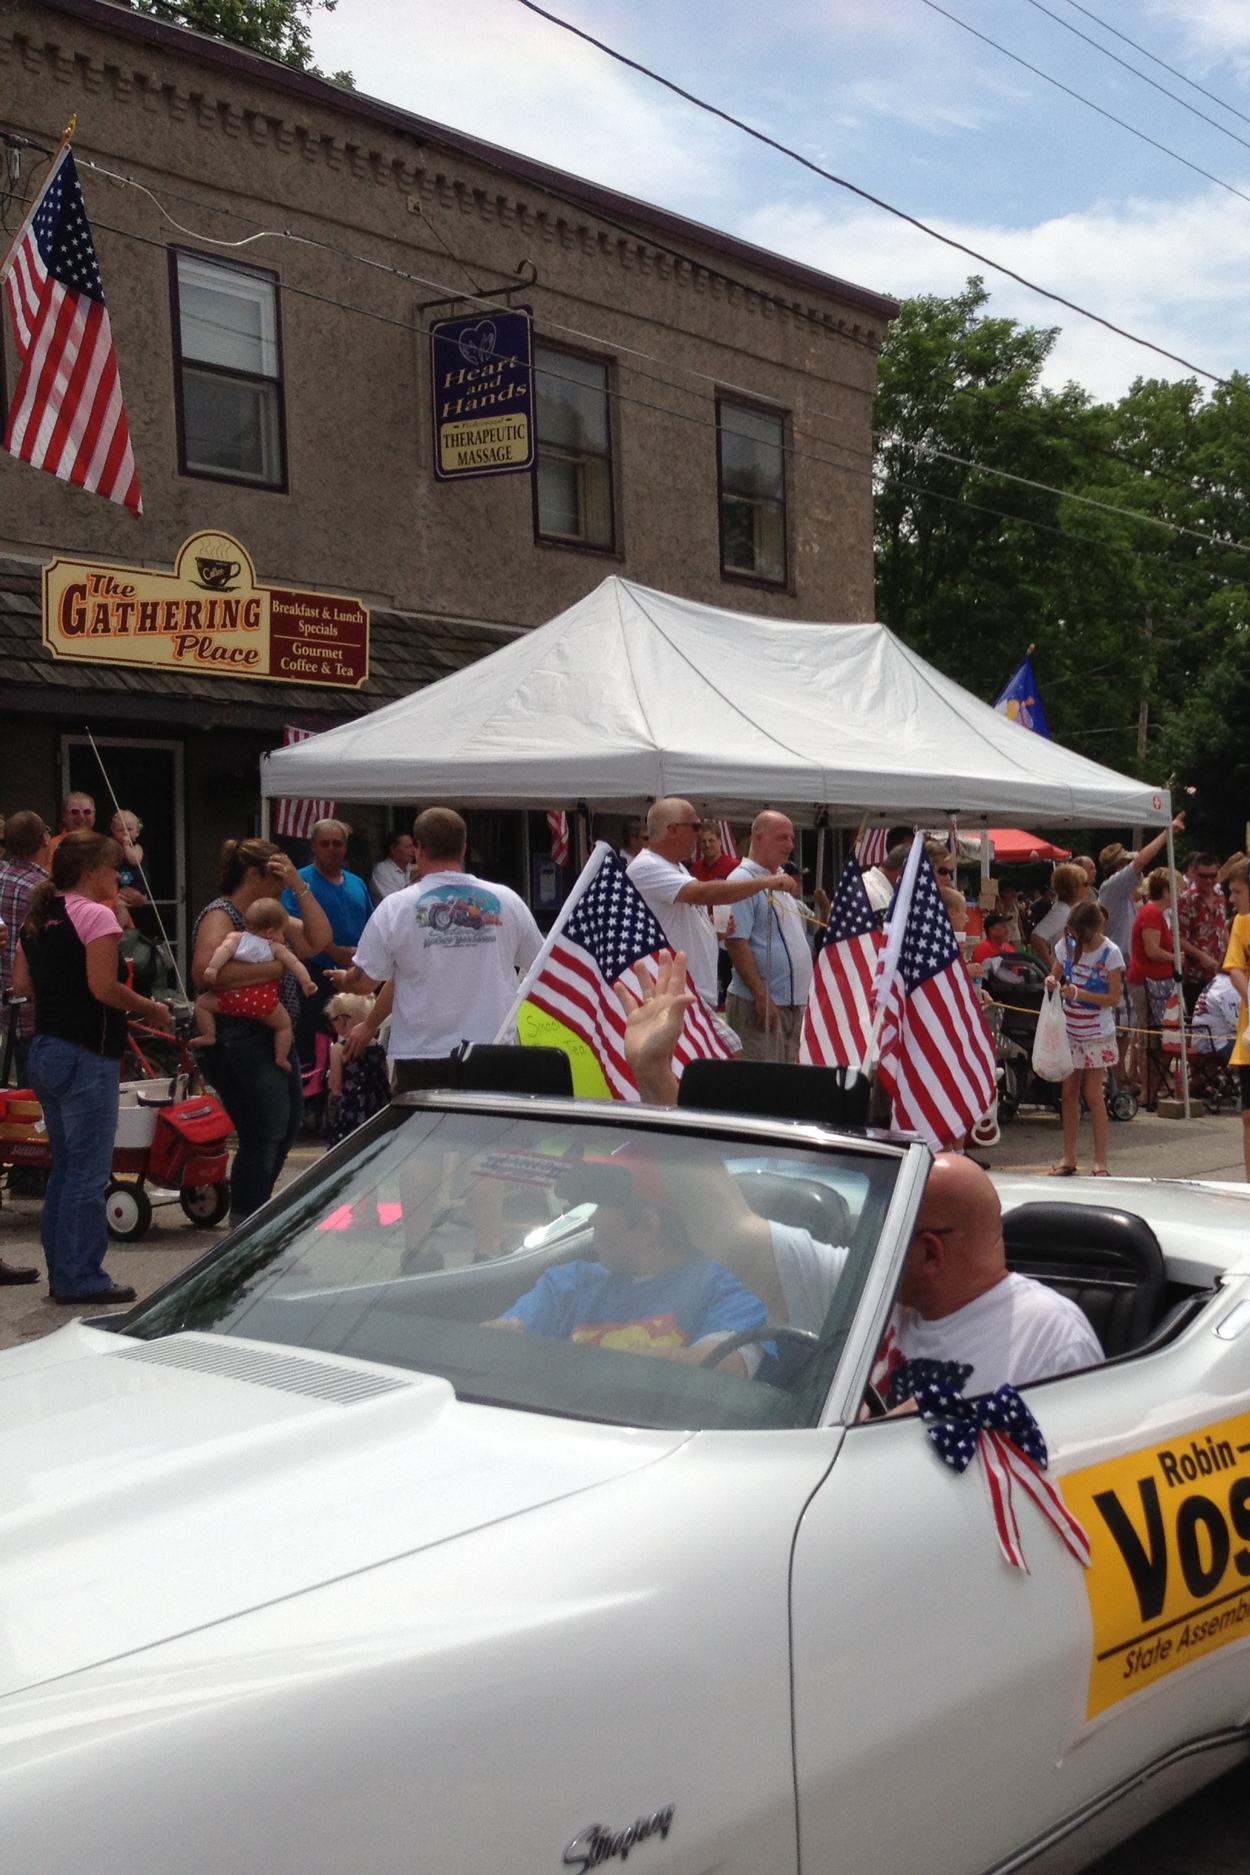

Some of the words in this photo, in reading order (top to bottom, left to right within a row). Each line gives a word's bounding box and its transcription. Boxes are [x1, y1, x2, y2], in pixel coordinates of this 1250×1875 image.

[443, 355, 518, 389] Heart
[466, 375, 502, 395] and
[442, 382, 527, 418] Hands
[443, 424, 525, 449] THERAPEUTIC
[457, 445, 512, 466] MASSAGE
[89, 573, 136, 599] The
[272, 600, 319, 618] Breakfast
[322, 607, 331, 619] &
[334, 608, 364, 623] Lunch
[298, 620, 339, 636] Specials
[173, 634, 261, 665] Place
[292, 642, 343, 659] Gourmet
[280, 657, 318, 672] Coffee
[321, 662, 331, 674] &
[335, 662, 354, 676] Tea
[1157, 1435, 1237, 1488] Robin
[1123, 1636, 1172, 1680] State
